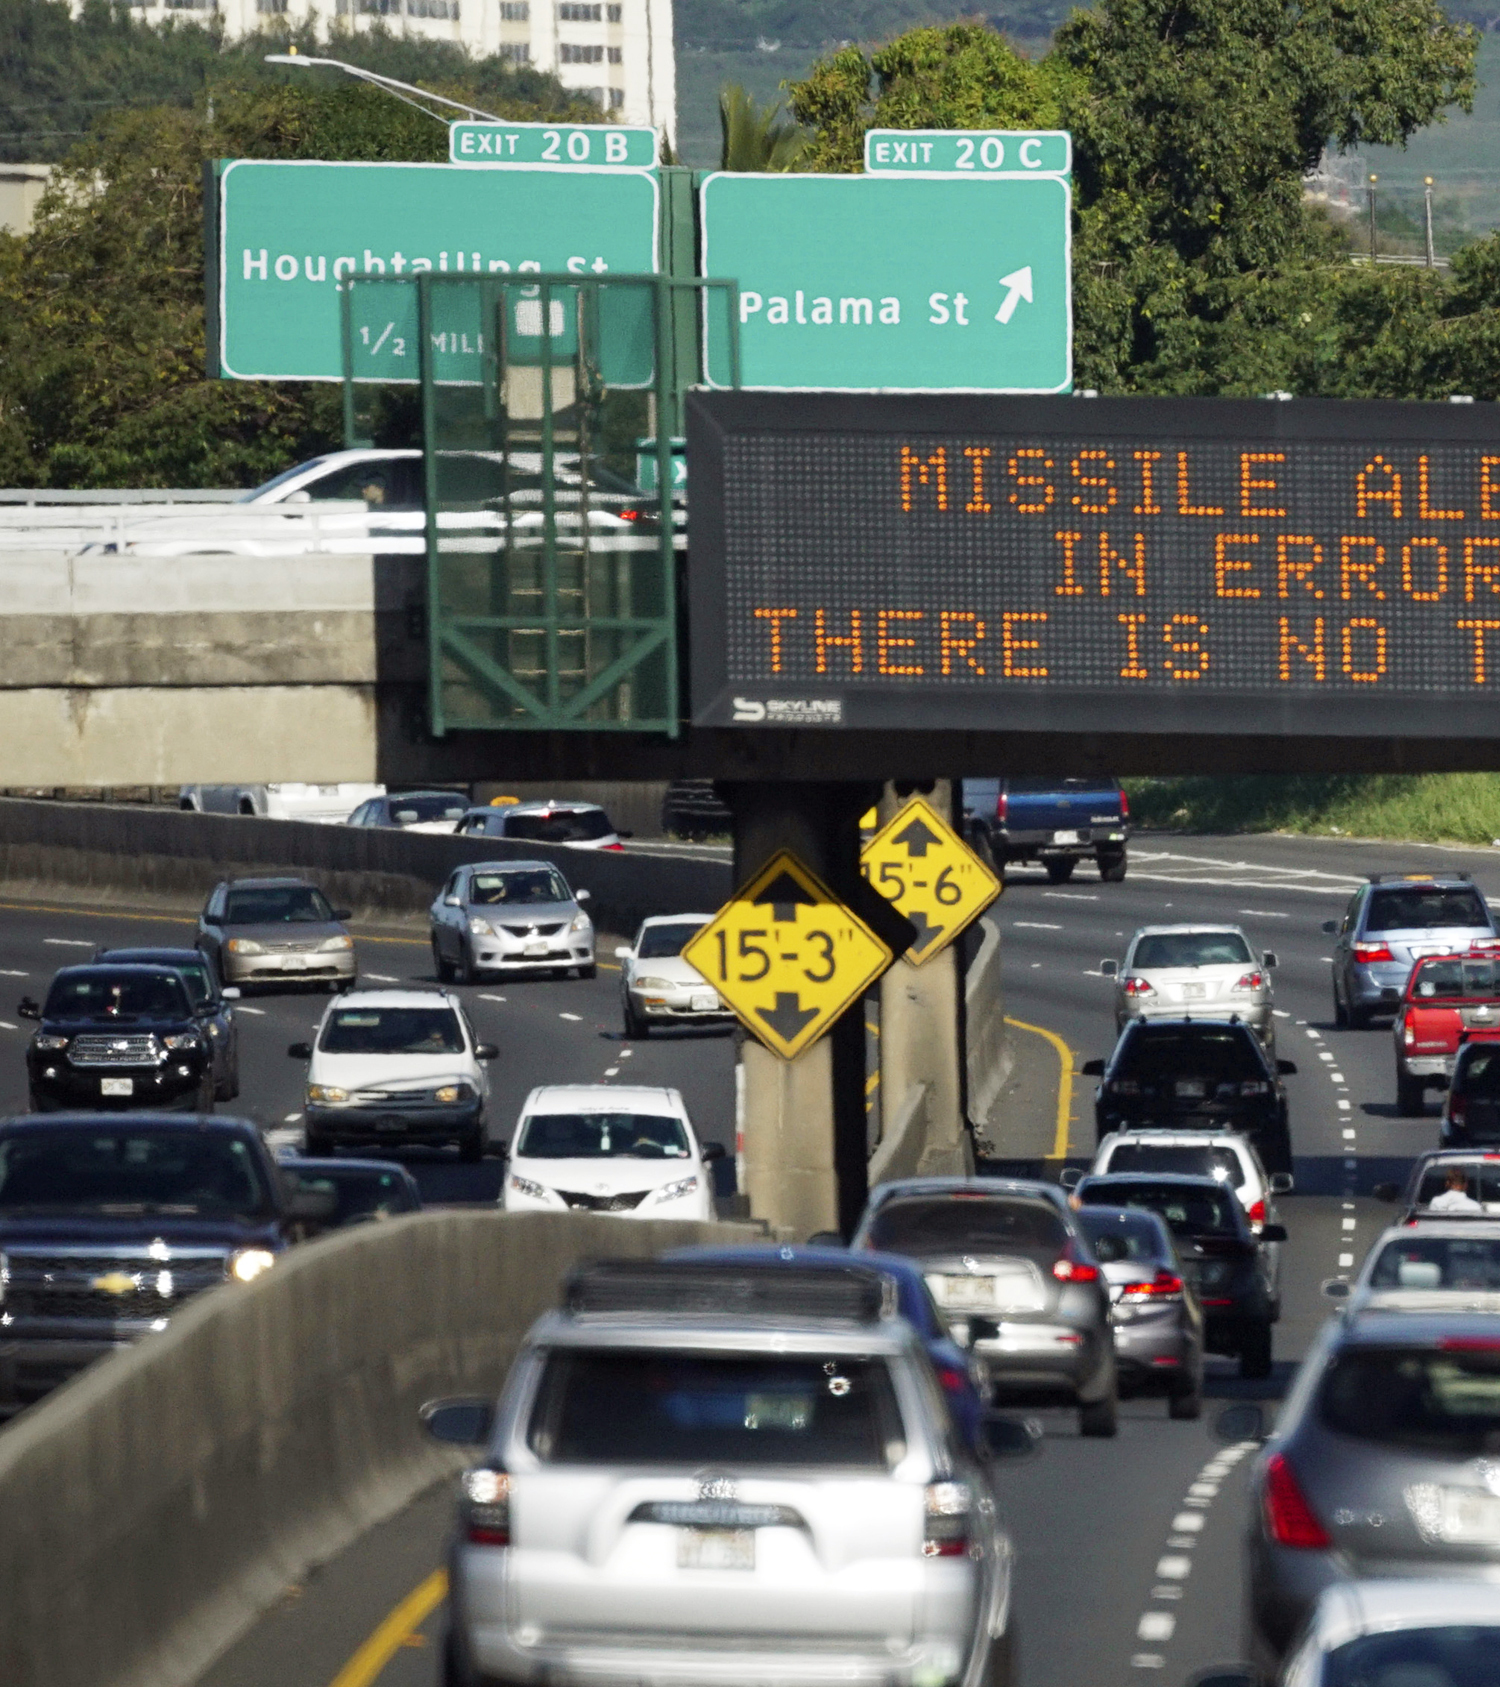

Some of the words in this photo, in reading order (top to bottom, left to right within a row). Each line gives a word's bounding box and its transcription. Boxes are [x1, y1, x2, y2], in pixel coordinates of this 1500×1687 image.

[460, 132, 520, 155] EXIT
[541, 130, 591, 163] 20
[604, 132, 629, 163] B
[875, 141, 934, 164] EXIT
[955, 137, 1005, 169] 20
[1018, 138, 1043, 169] C
[738, 290, 901, 325] Palama
[928, 291, 970, 326] St
[359, 322, 406, 357] 1/2
[899, 446, 1288, 517] MISSILE
[1053, 530, 1147, 597] IN
[753, 608, 1050, 677] THERE
[1116, 613, 1211, 680] IS
[1277, 616, 1388, 683] NO
